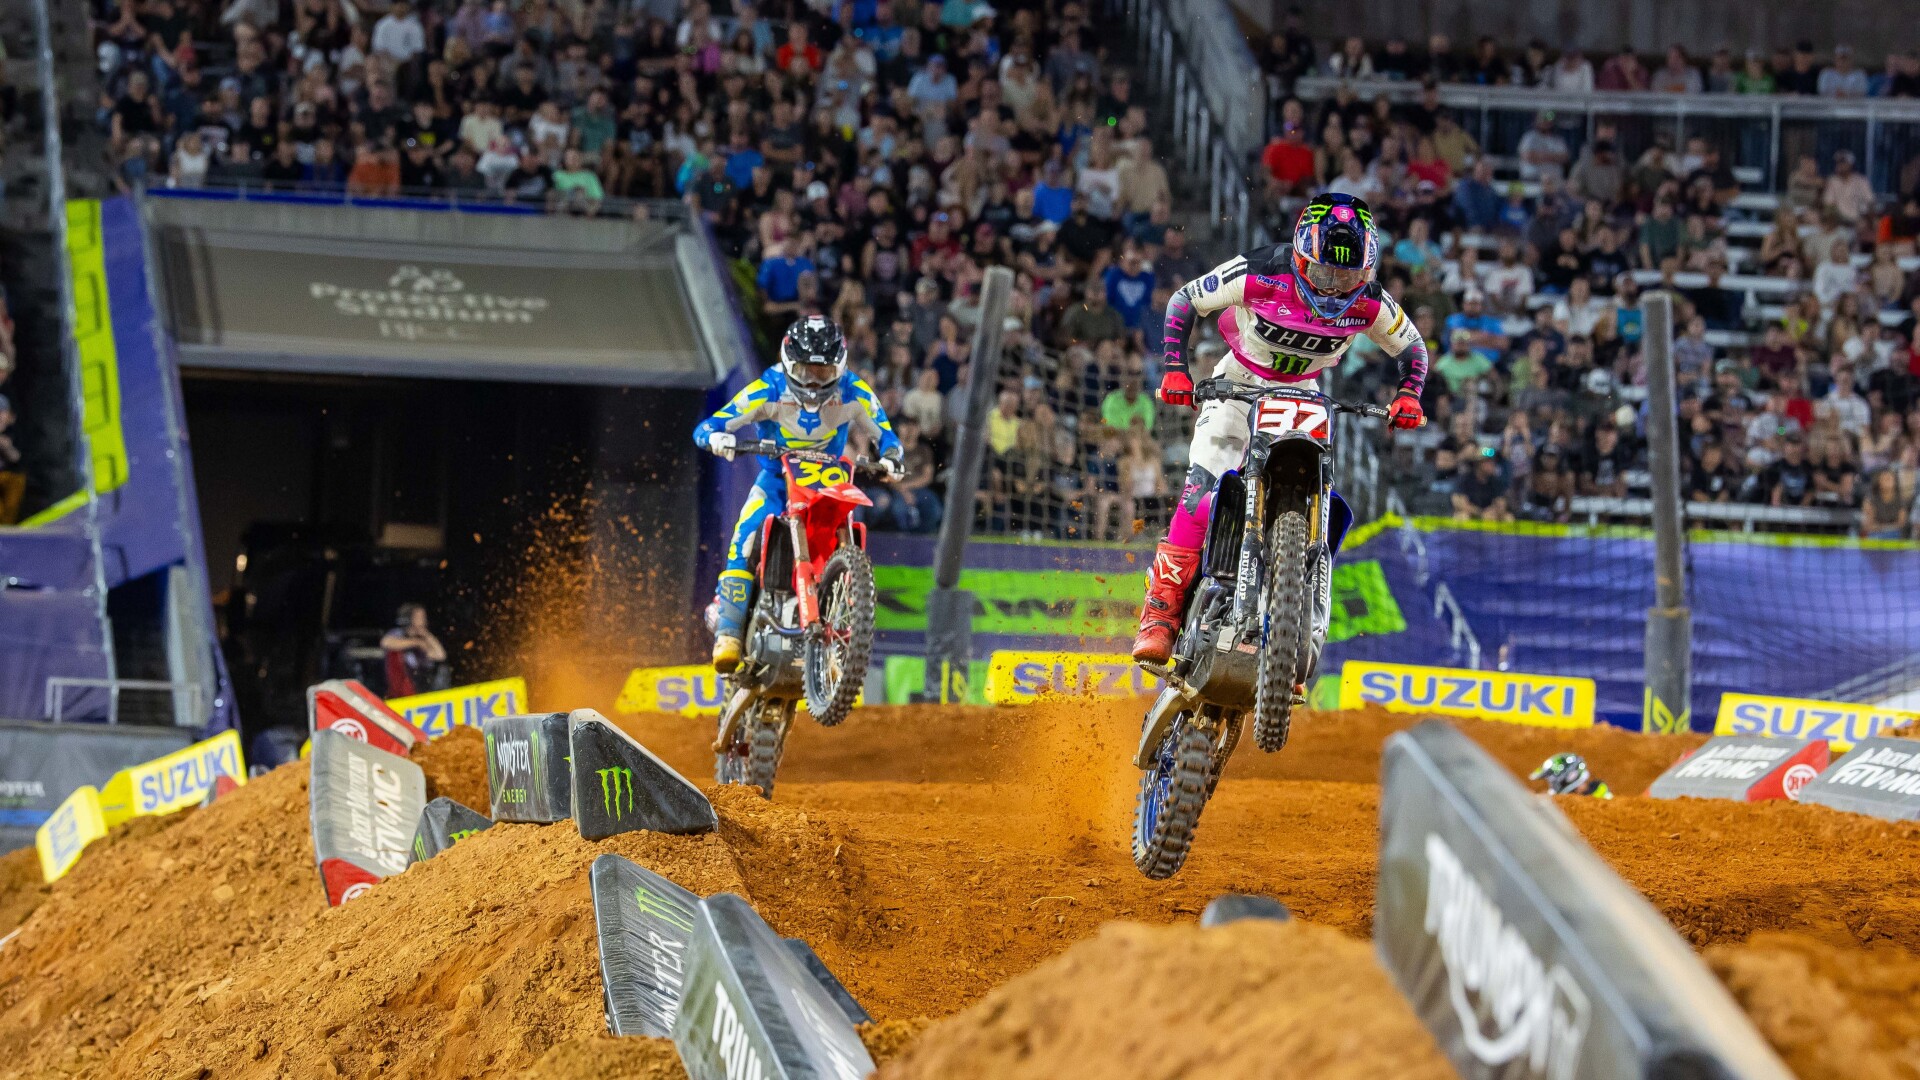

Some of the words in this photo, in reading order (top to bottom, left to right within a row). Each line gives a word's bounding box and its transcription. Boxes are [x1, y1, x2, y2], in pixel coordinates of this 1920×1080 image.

[1258, 400, 1328, 435] 37
[796, 461, 849, 487] 30
[1239, 551, 1250, 601] DUNLOP
[1320, 555, 1328, 608] DUNLOP
[1013, 662, 1167, 697] SUZU
[1360, 671, 1576, 717] SUZUKI
[404, 691, 516, 738] ZUKI
[1732, 703, 1912, 744] SUZU
[141, 744, 239, 811] SUZUKI
[497, 731, 531, 778] MONSTER
[502, 789, 527, 804] ENERGY
[711, 980, 775, 1080] TRIU
